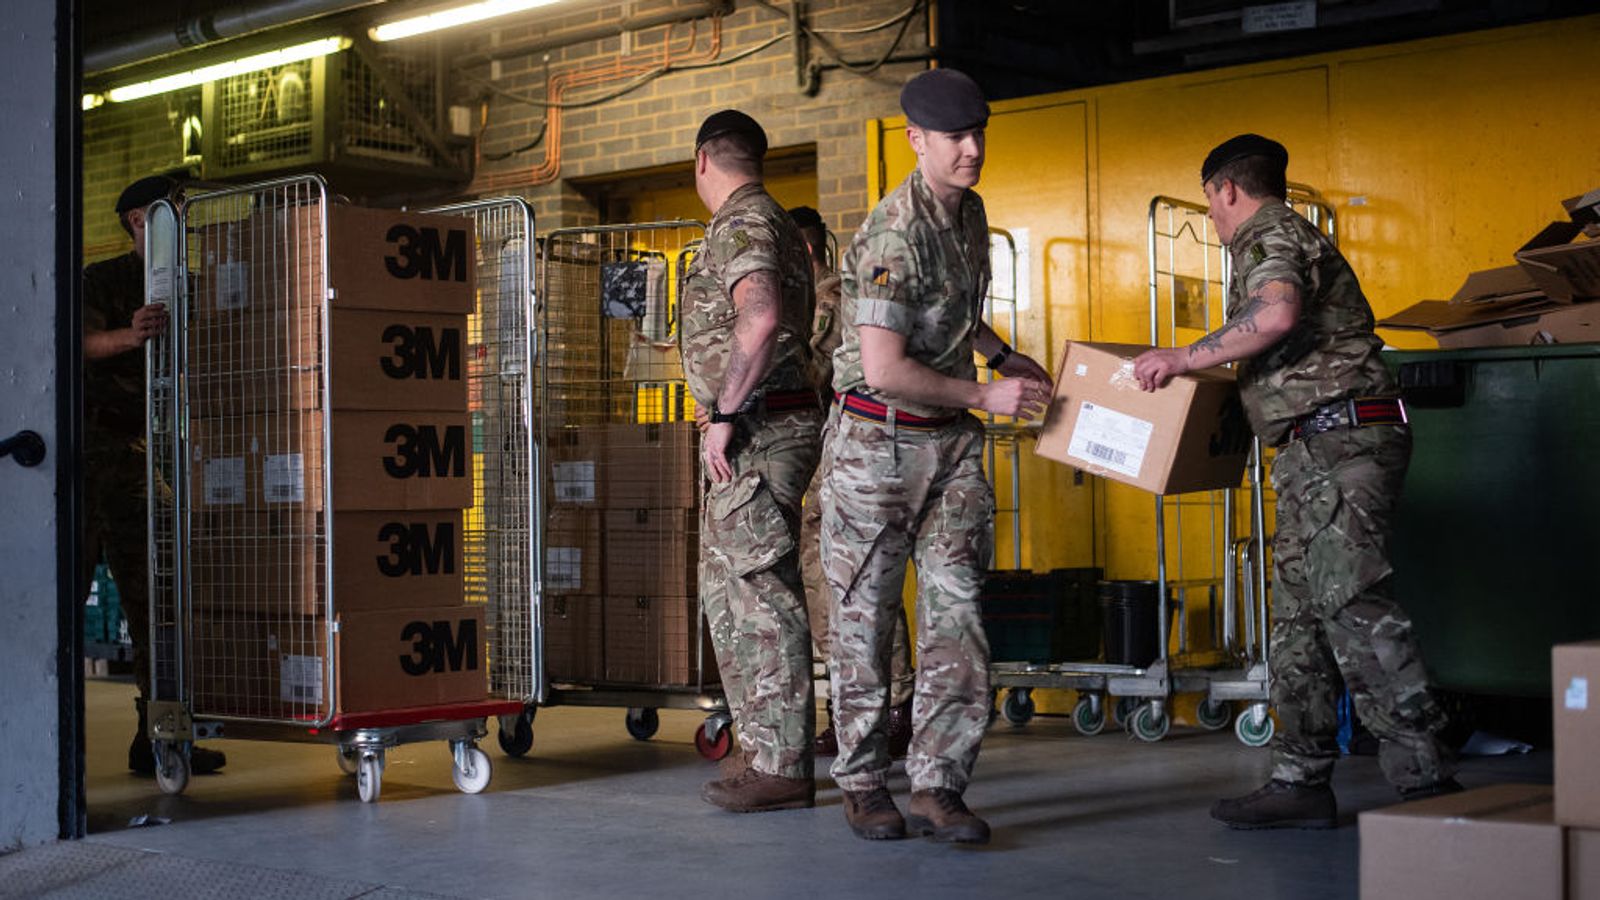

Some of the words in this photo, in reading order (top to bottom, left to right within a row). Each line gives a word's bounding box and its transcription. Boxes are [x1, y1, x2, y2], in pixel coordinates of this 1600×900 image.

[384, 224, 467, 283] 3M
[380, 324, 461, 381] 3M
[382, 424, 466, 480] 3M
[376, 522, 455, 578] 3M
[399, 619, 478, 677] 3M
